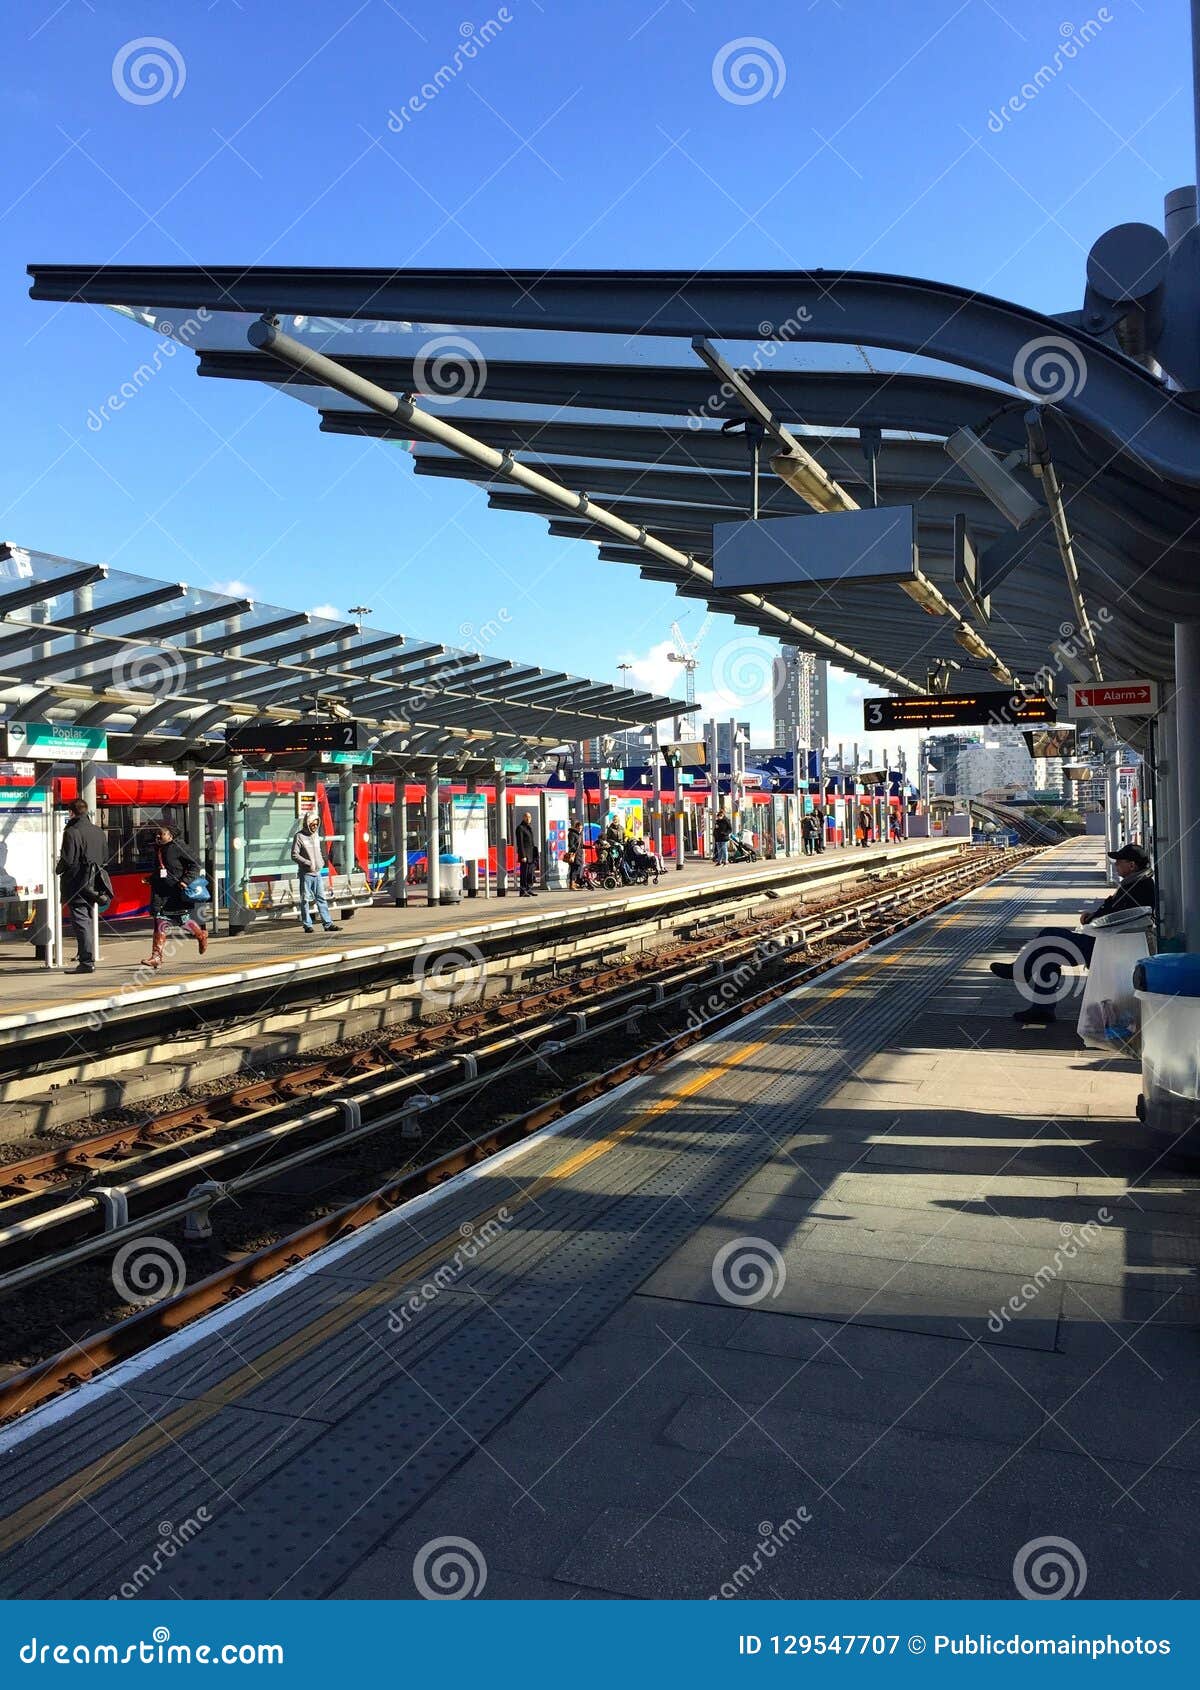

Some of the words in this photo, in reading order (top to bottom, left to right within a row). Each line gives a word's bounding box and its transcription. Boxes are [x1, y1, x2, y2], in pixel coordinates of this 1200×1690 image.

[1103, 690, 1136, 701] Alarm
[869, 704, 883, 724] 3
[52, 726, 83, 741] Poplar
[343, 727, 354, 745] 2
